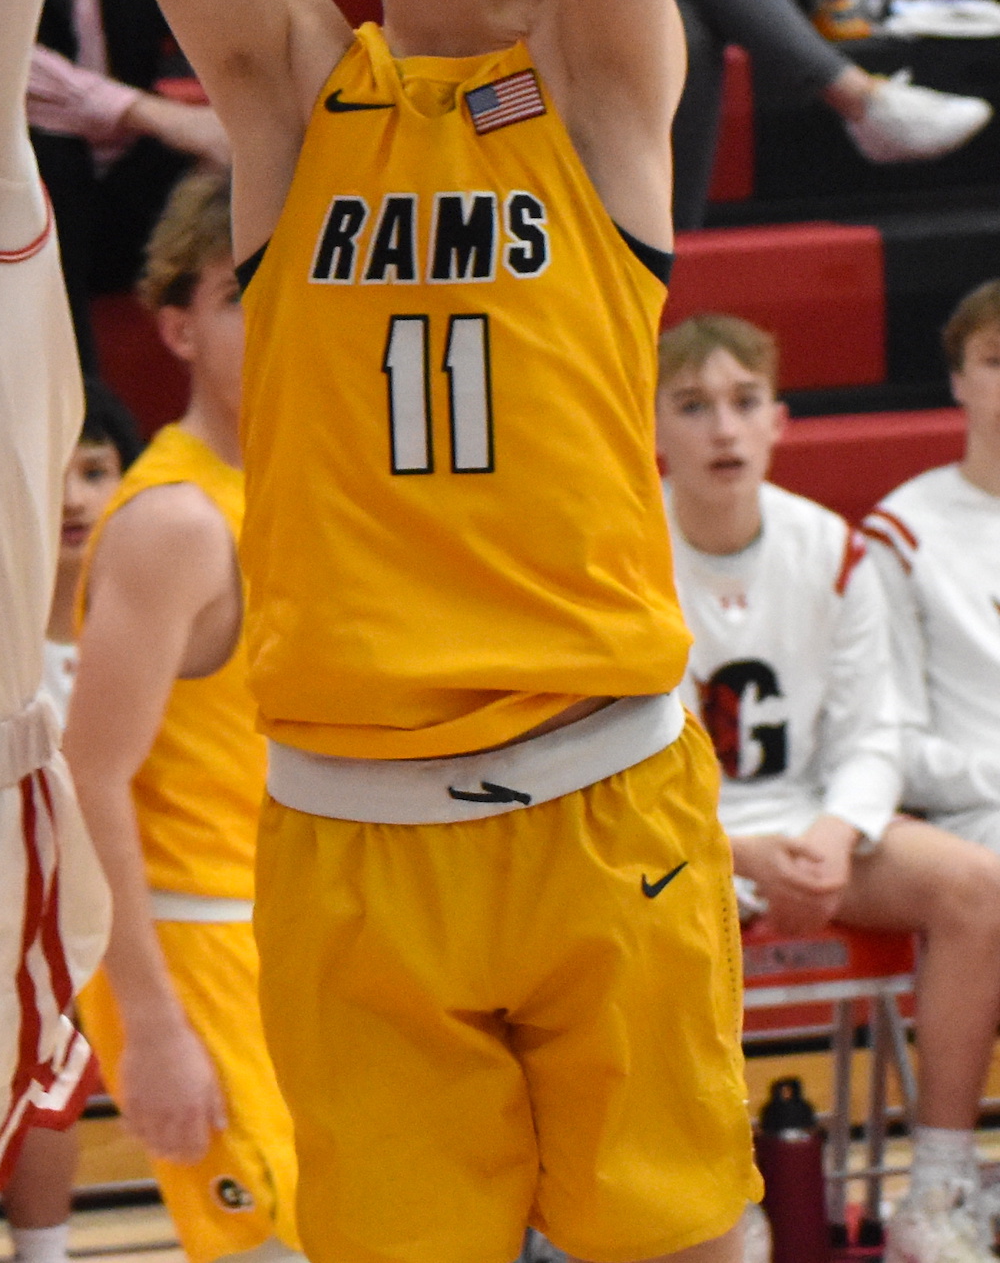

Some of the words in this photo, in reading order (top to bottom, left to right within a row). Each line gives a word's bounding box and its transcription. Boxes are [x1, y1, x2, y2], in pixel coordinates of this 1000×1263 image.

[308, 190, 551, 285] RAMS
[381, 314, 494, 475] 11
[694, 659, 787, 780] G
